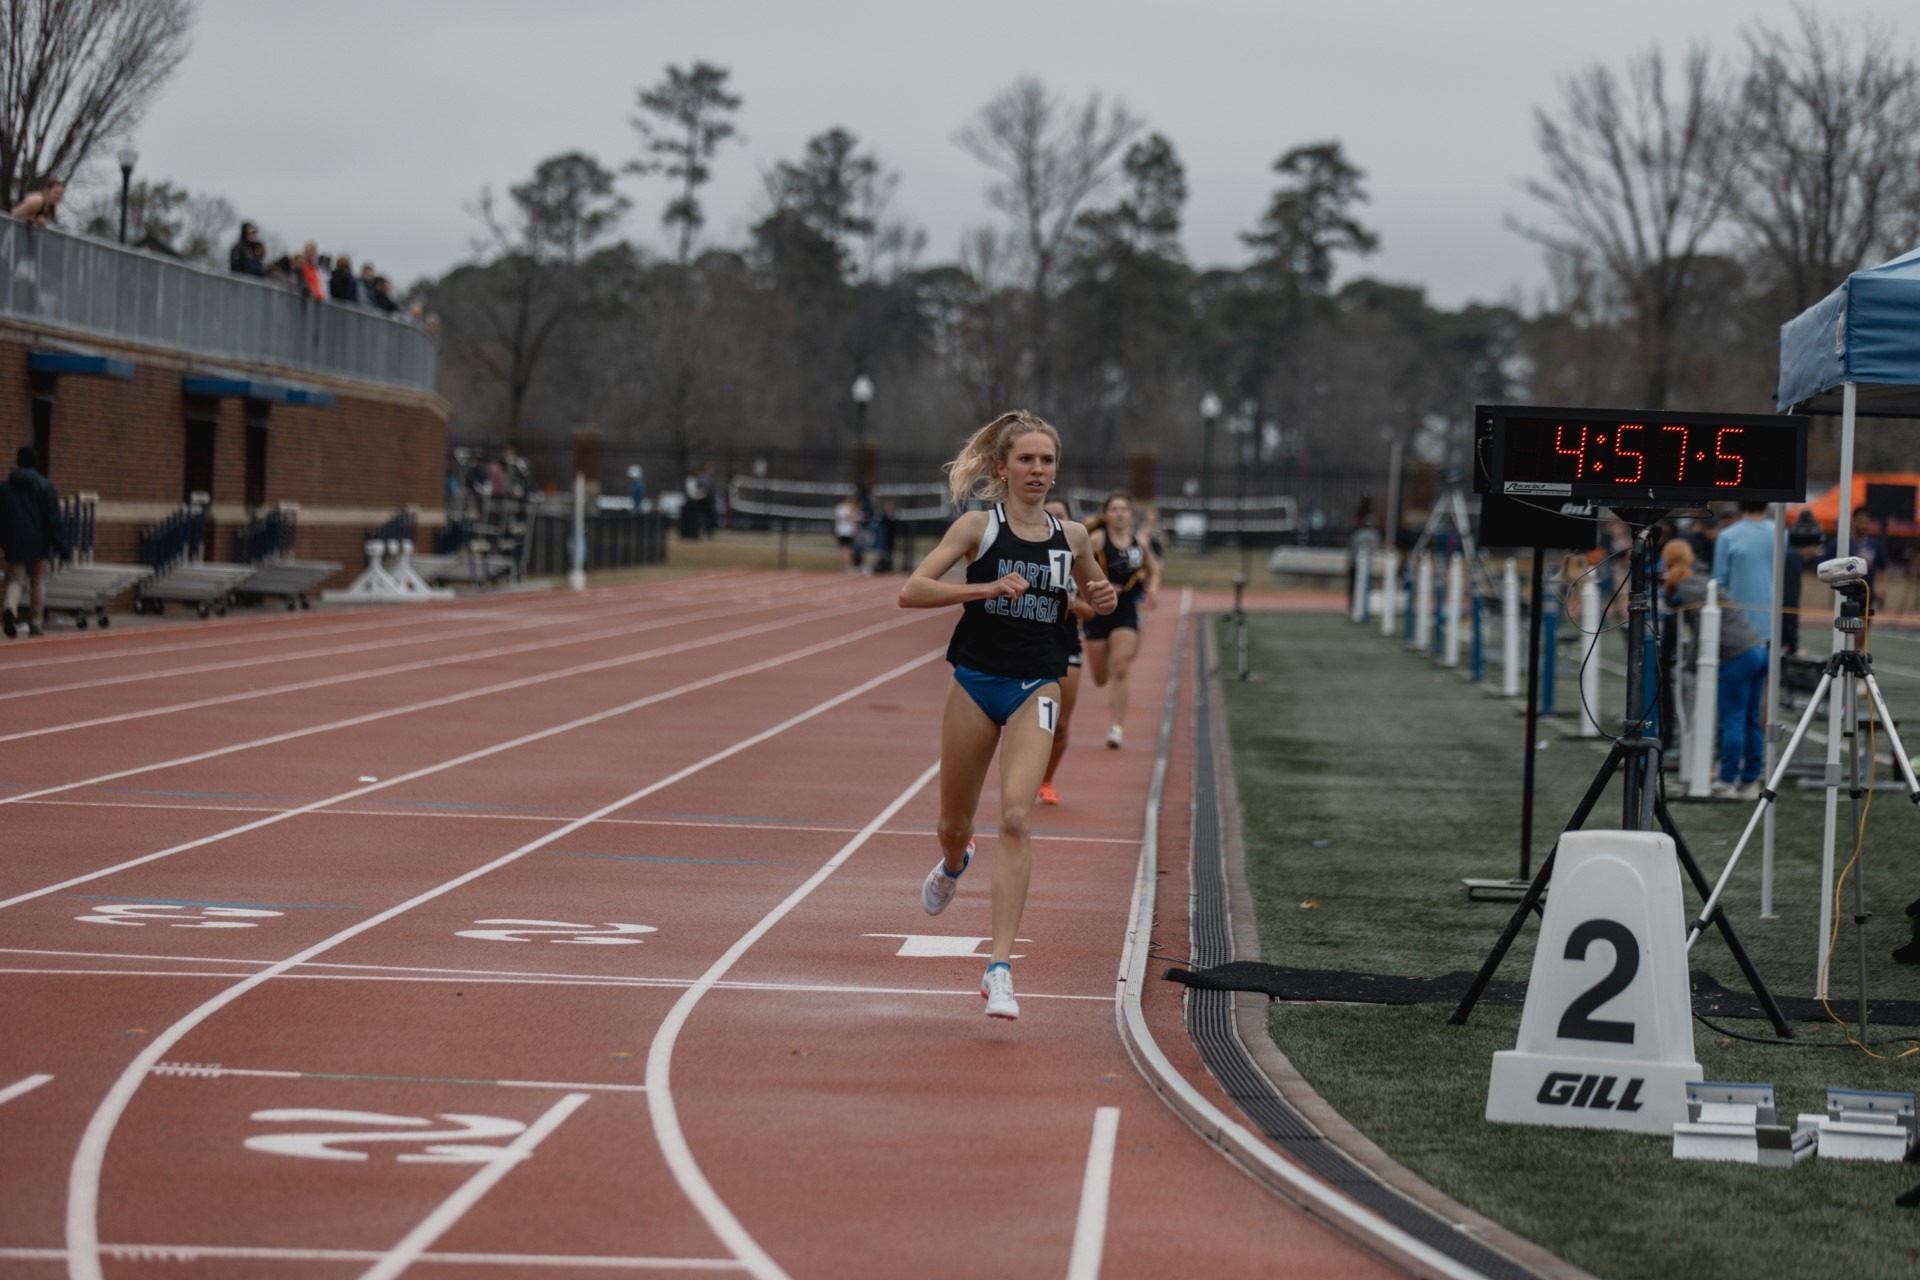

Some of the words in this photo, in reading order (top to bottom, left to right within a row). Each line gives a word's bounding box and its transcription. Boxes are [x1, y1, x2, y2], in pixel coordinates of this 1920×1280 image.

[998, 559, 1059, 593] NORT
[1053, 553, 1066, 586] 1
[984, 594, 1060, 623] GEORGIA
[1042, 701, 1053, 731] 1
[1556, 918, 1640, 1045] 2
[1536, 1071, 1645, 1113] GILL
